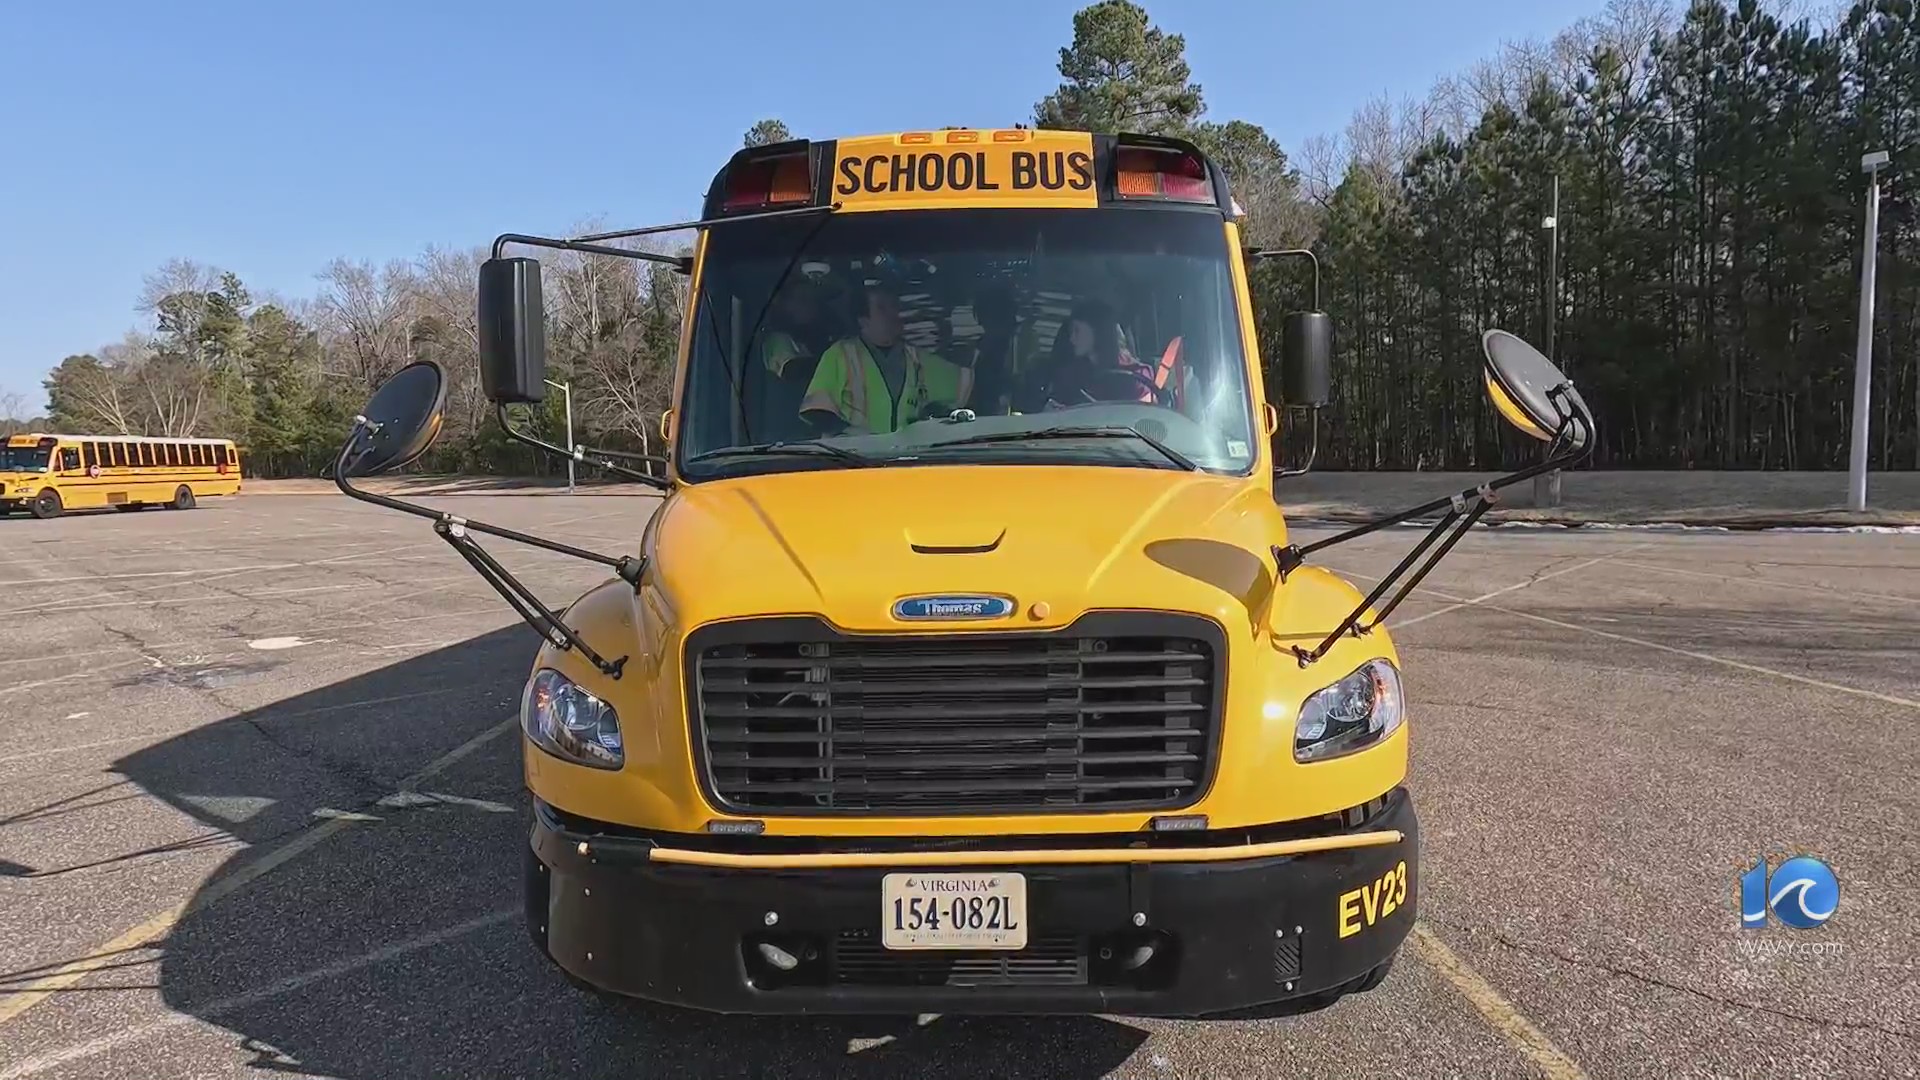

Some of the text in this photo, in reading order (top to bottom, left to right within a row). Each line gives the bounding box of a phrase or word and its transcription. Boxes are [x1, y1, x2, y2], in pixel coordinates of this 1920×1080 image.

[837, 151, 1093, 195] SCHOOL BUS
[917, 599, 990, 614] Thomas
[920, 880, 988, 892] VIRGINIA
[1339, 861, 1407, 939] EV23
[894, 896, 1018, 930] 154-082L
